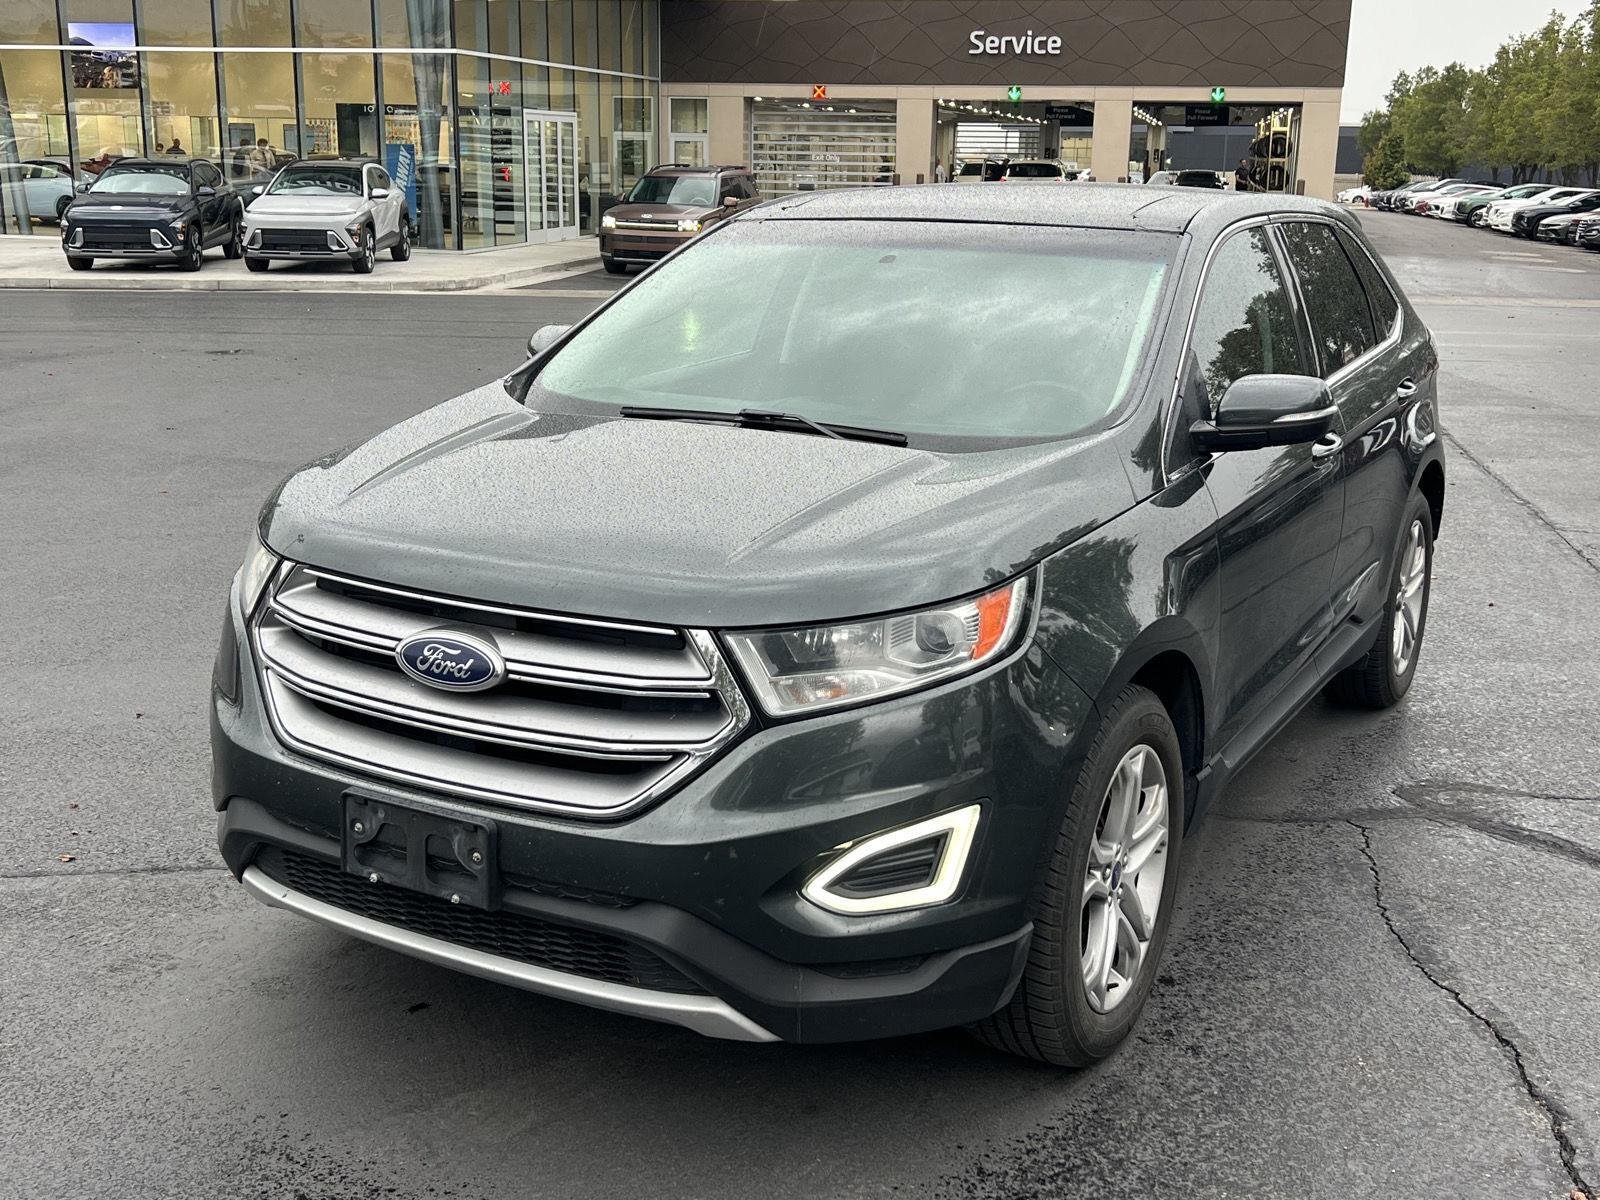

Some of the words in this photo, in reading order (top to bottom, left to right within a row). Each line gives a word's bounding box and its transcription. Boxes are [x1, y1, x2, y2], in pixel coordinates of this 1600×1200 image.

[969, 30, 1061, 54] Service
[811, 153, 824, 161] Exit
[825, 153, 840, 163] Only
[416, 643, 474, 679] Ford
